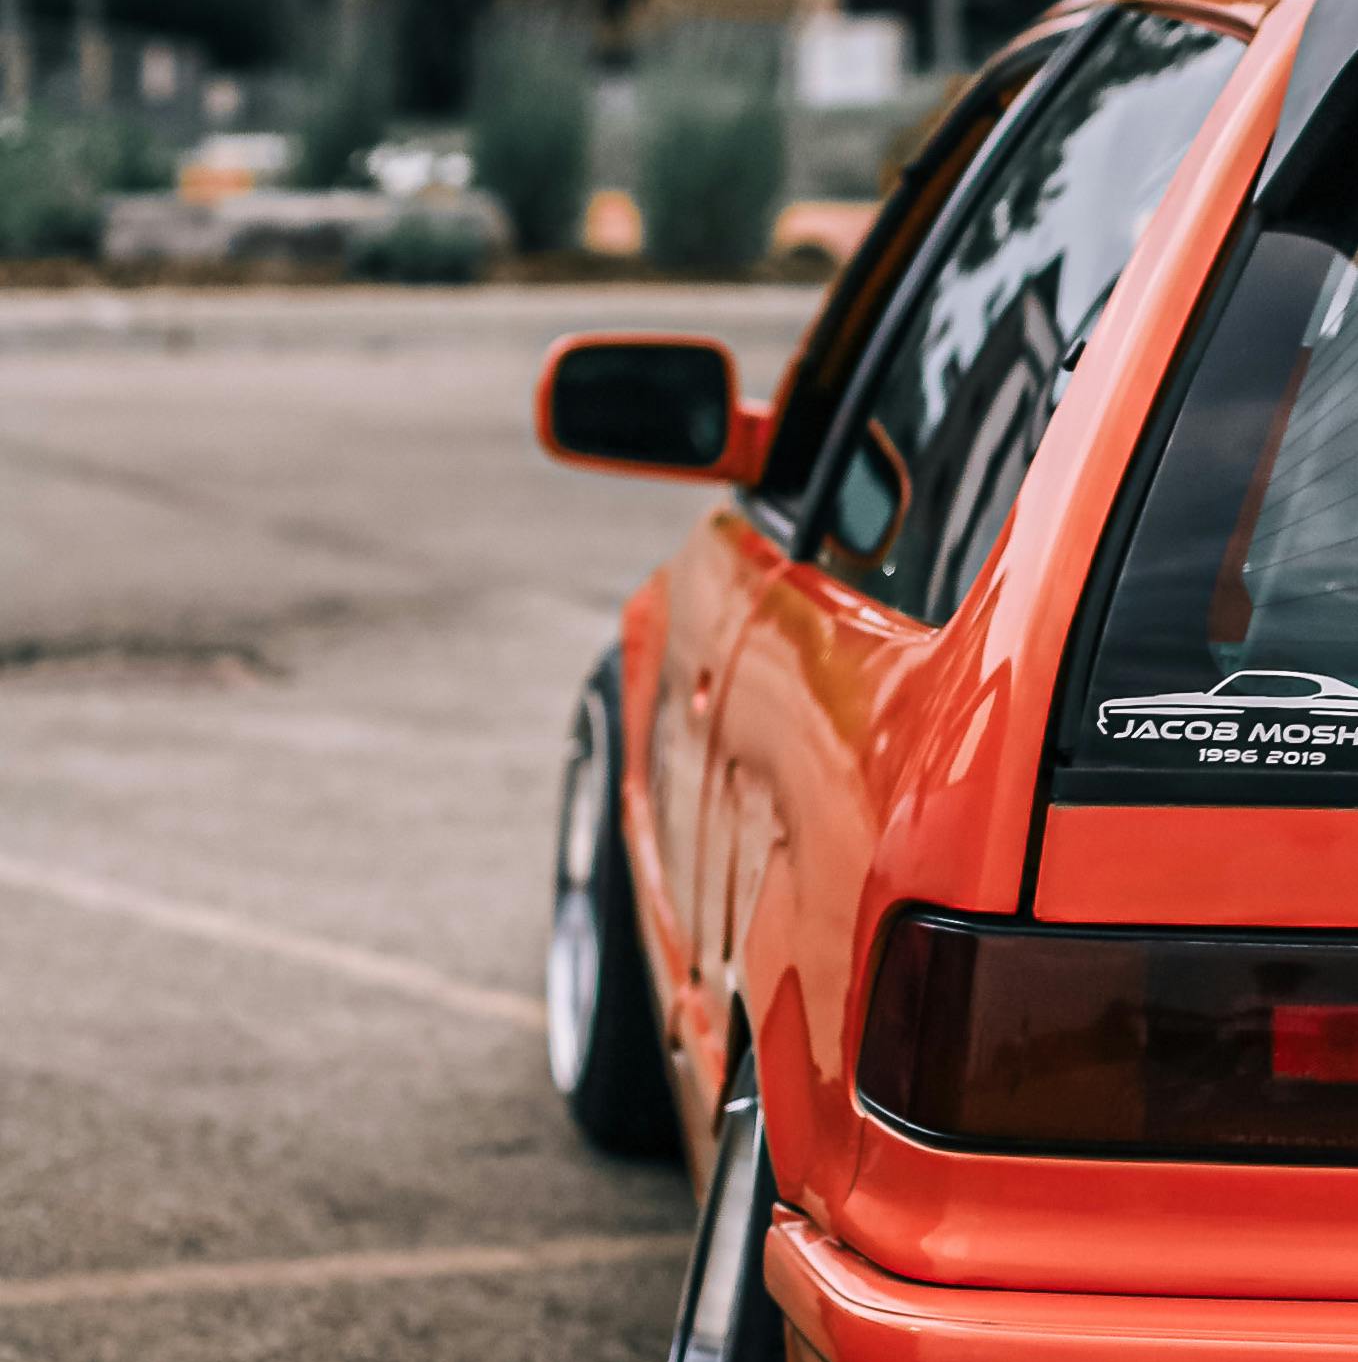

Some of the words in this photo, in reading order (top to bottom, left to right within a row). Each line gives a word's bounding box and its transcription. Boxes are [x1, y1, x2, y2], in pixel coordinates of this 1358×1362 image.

[1112, 718, 1240, 742] JACOB
[1198, 747, 1259, 764] 1996
[1266, 750, 1327, 766] 2019
